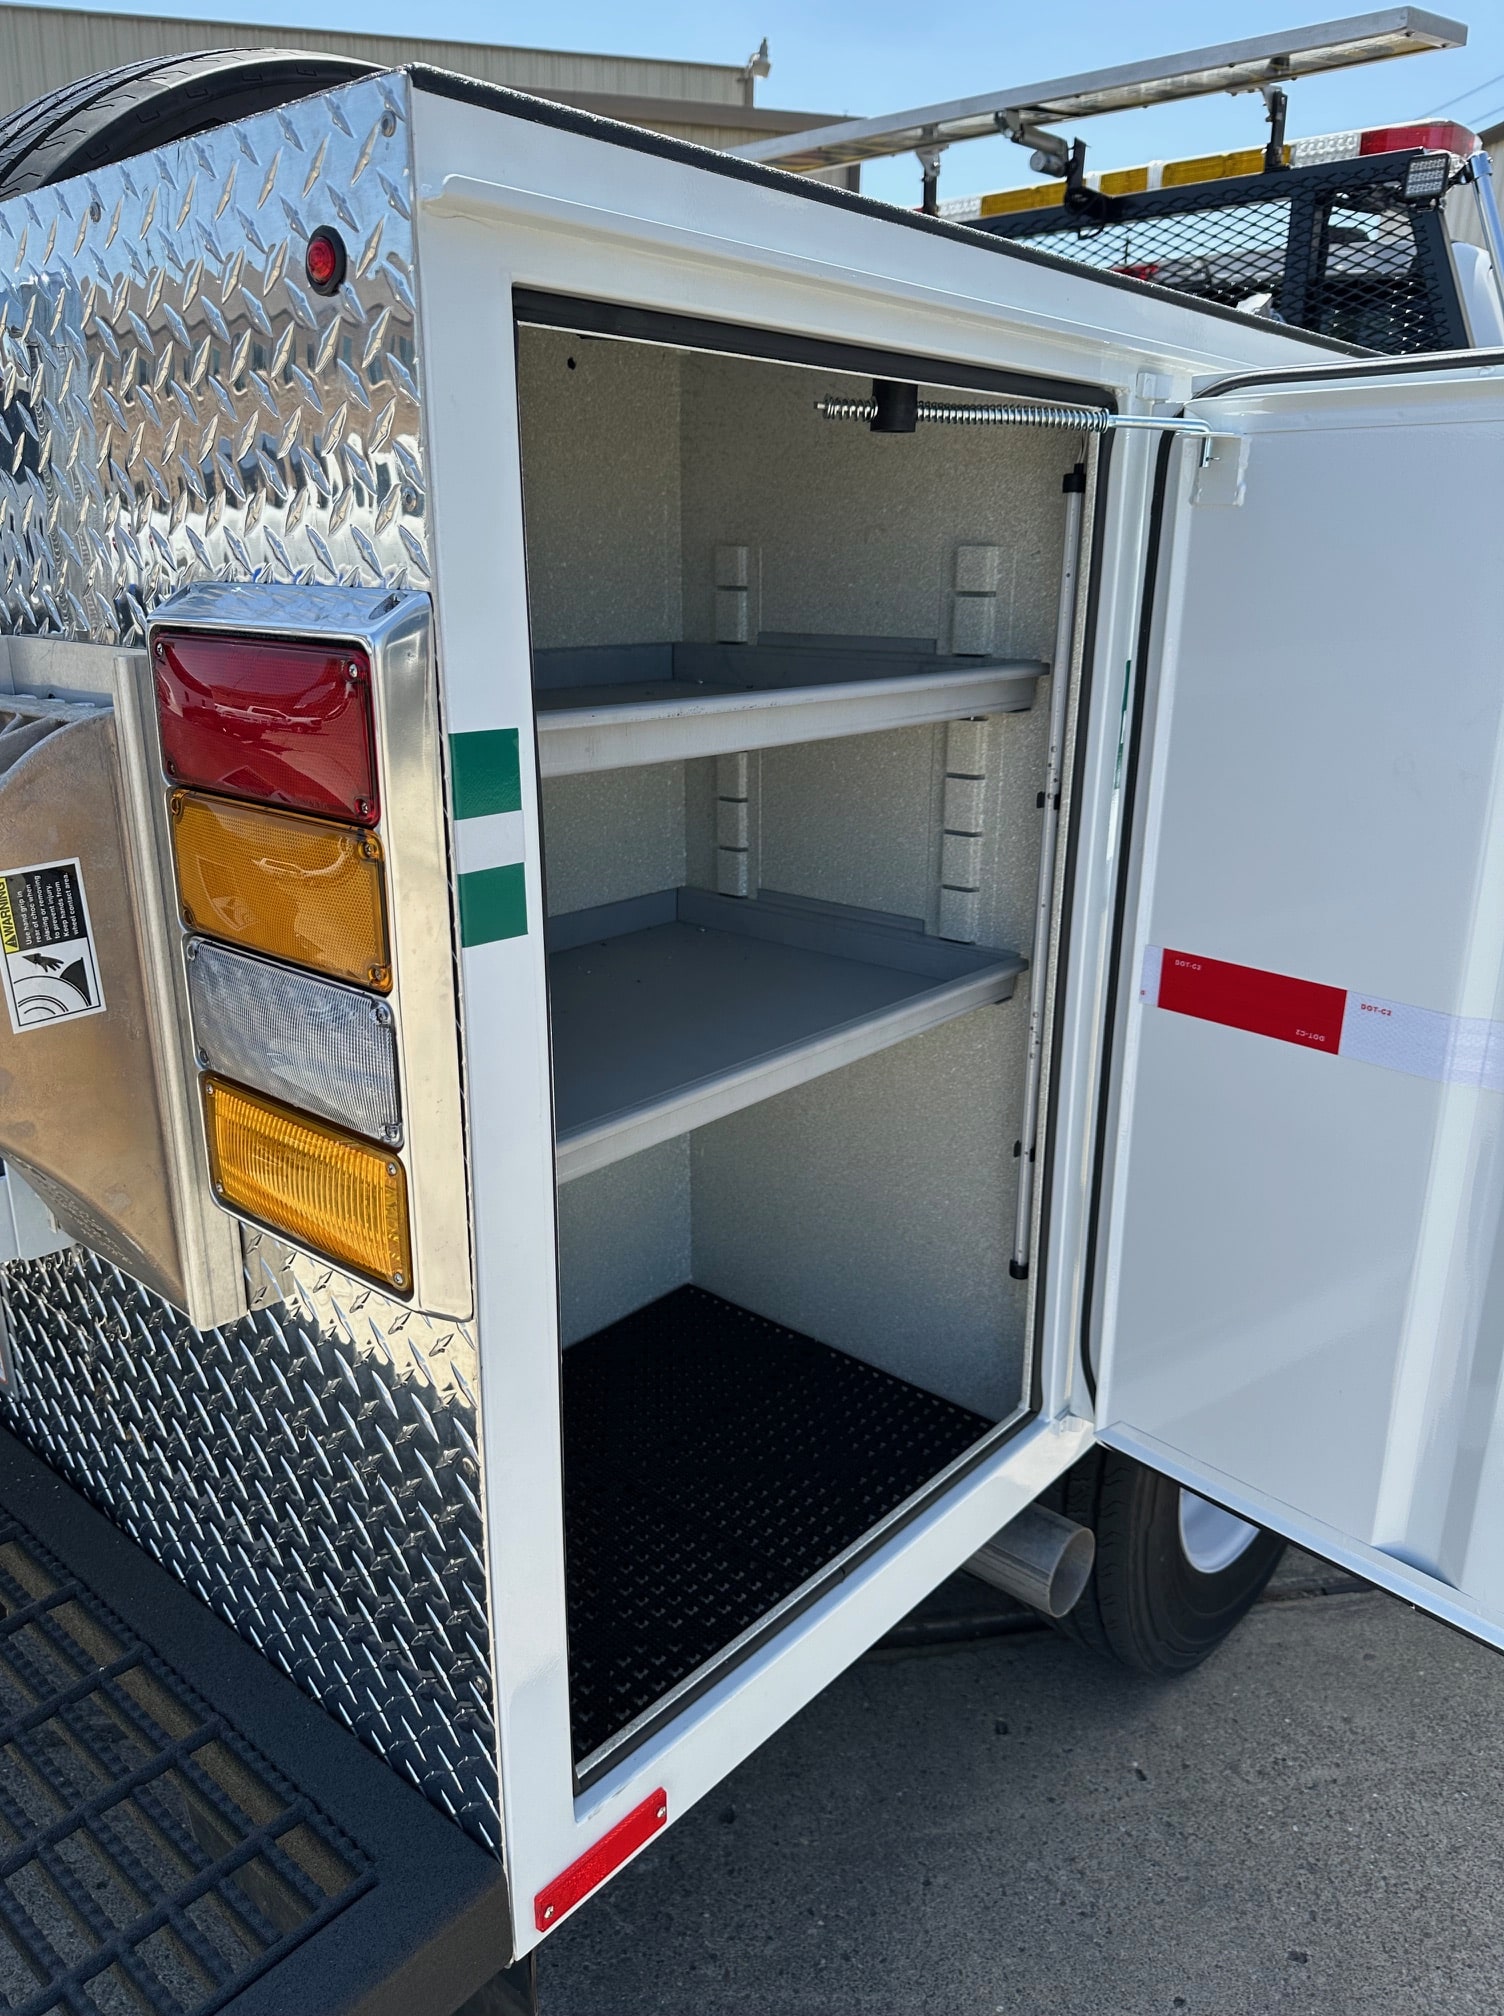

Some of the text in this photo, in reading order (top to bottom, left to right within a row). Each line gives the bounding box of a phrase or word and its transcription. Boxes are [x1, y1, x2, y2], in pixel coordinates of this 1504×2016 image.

[26, 884, 34, 903] when
[34, 875, 44, 907] removing
[46, 883, 60, 939] to prevent injury.
[58, 898, 67, 919] hands
[63, 872, 79, 935] wheel contact area.
[17, 890, 33, 945] Use hand grip in
[62, 919, 70, 937] Keep
[34, 929, 42, 943] rear
[42, 916, 52, 941] placing
[1361, 1003, 1392, 1016] DOT-C2
[1295, 1029, 1325, 1042] DOT-C2
